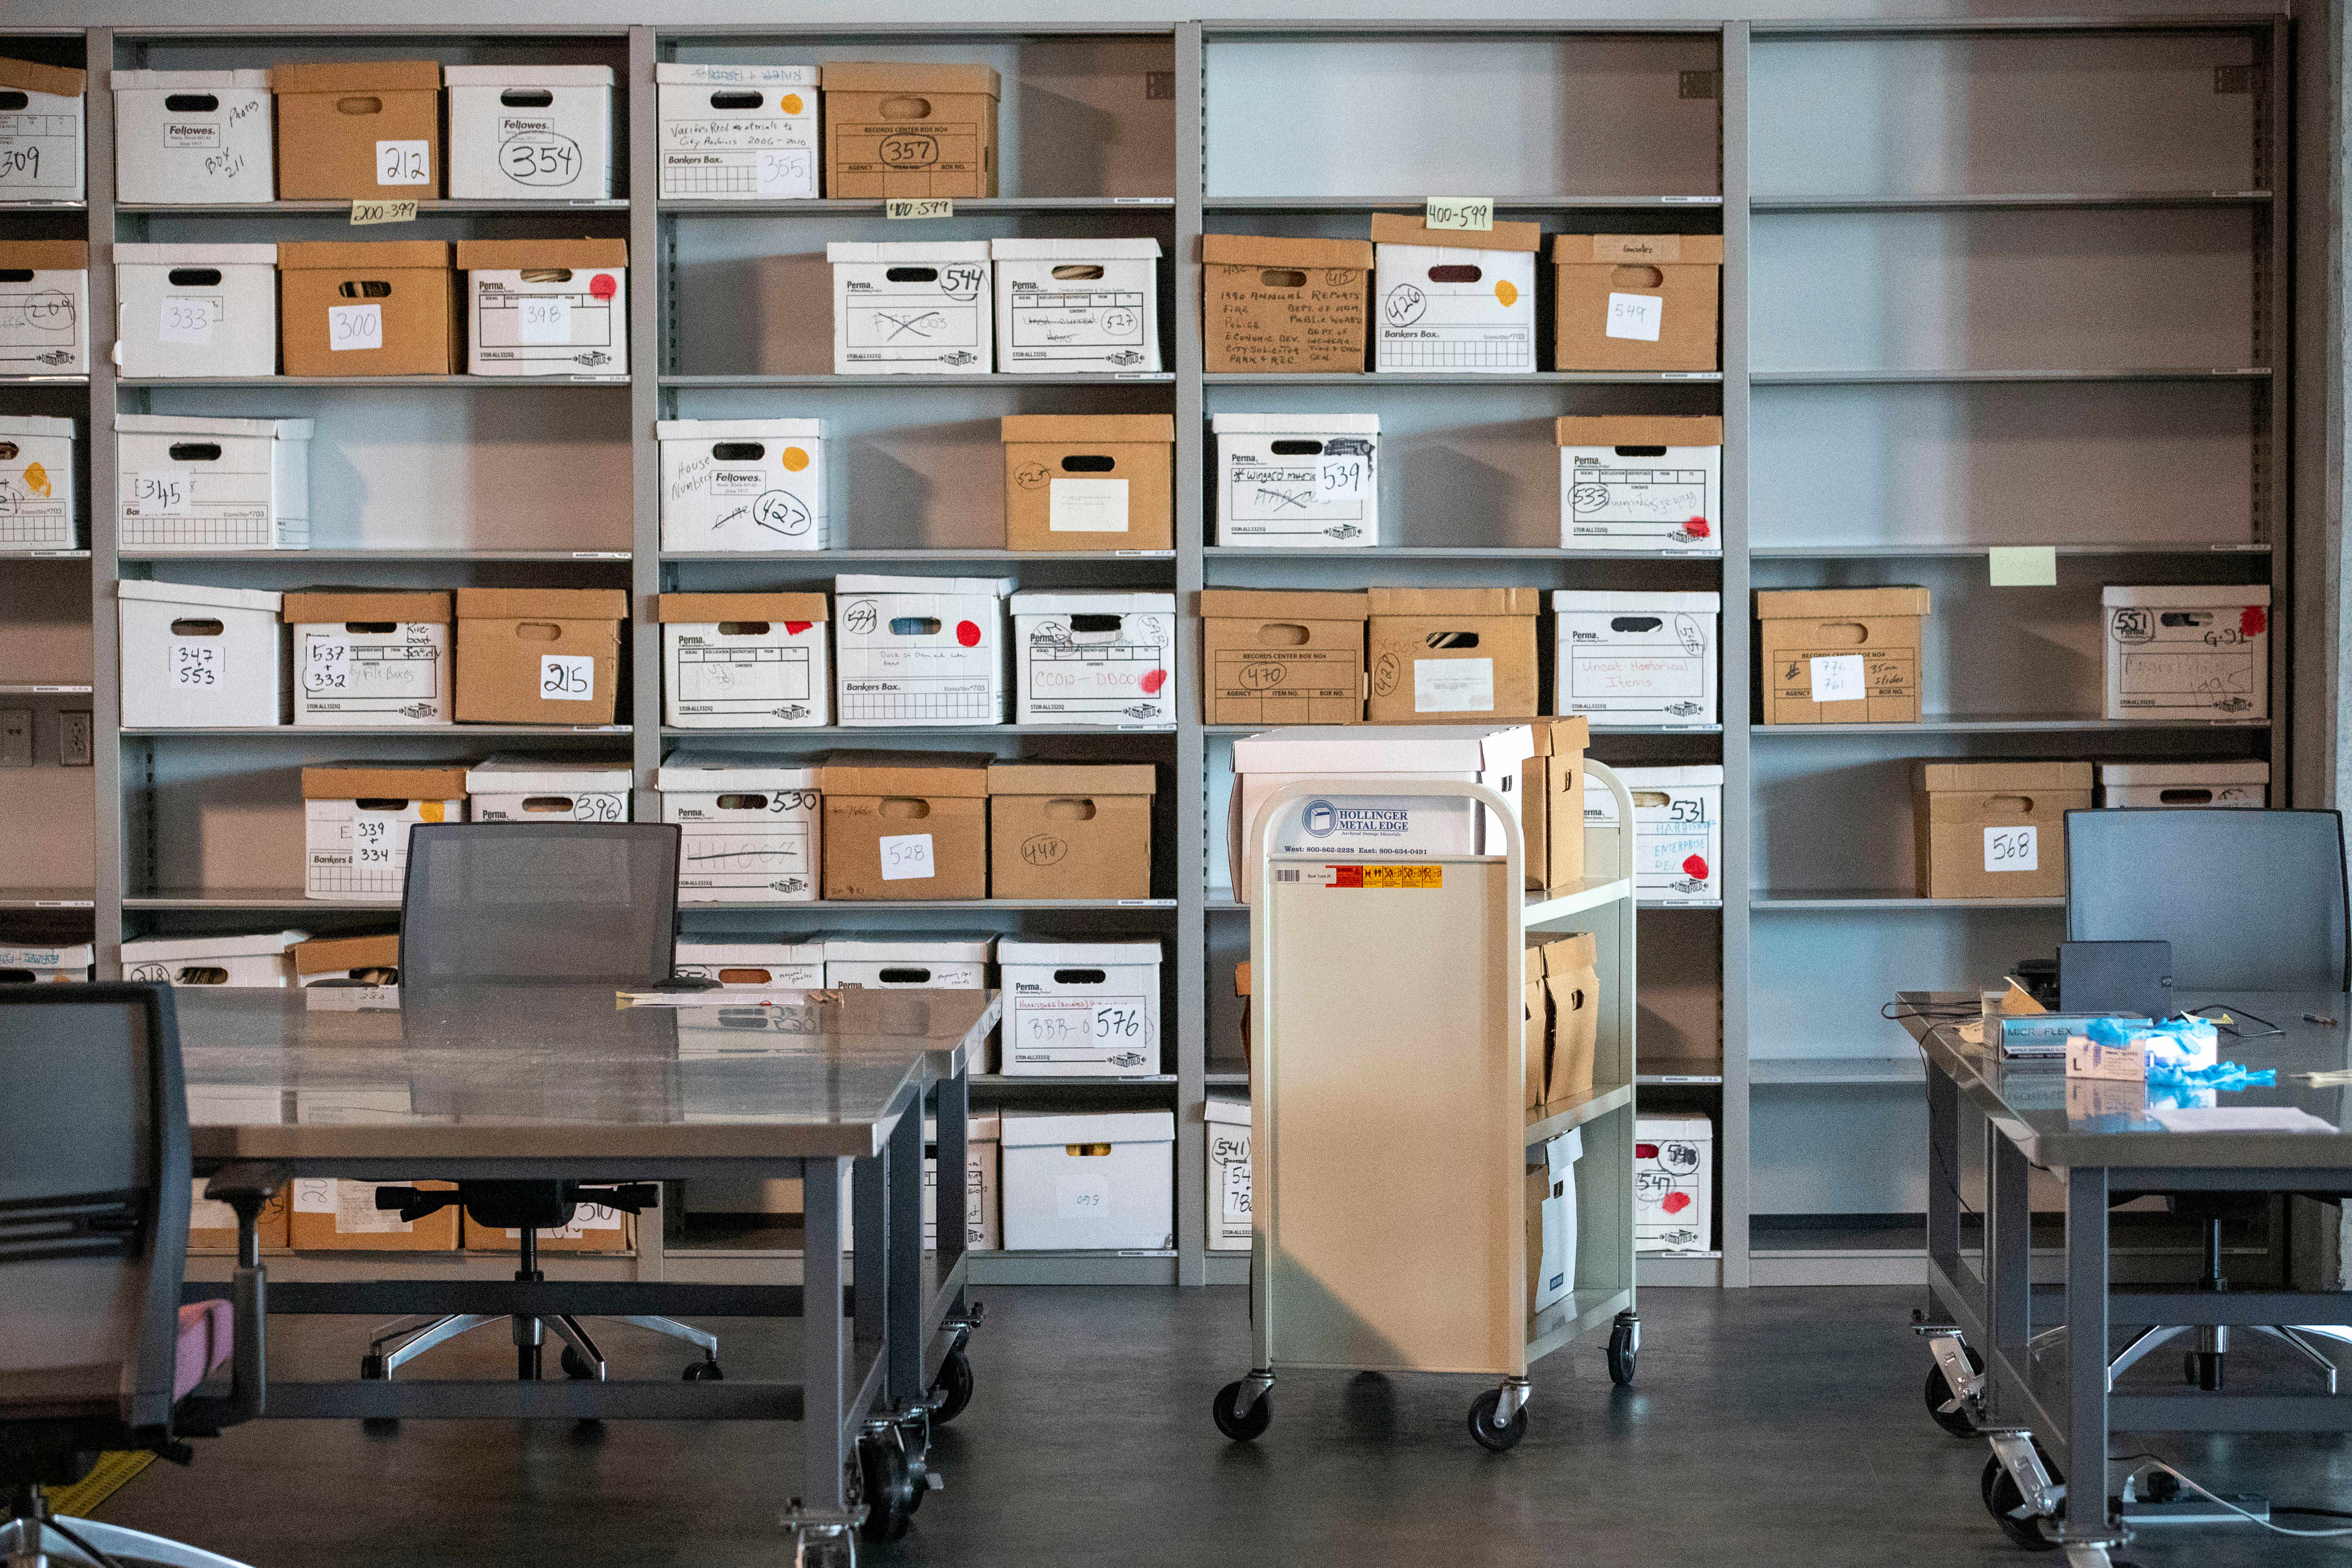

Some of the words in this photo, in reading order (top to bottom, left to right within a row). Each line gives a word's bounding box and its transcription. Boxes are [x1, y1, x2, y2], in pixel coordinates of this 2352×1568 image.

[669, 156, 701, 164] Bankers
[886, 141, 929, 160] 357
[0, 146, 39, 178] 309
[386, 148, 425, 178] 212
[513, 146, 572, 177] 354
[764, 155, 803, 183] 355
[354, 202, 414, 221] 200-399
[1429, 204, 1488, 228] 400-599
[947, 269, 984, 291] 544
[1328, 272, 1349, 283] 415
[1388, 288, 1420, 321] 426
[1615, 303, 1646, 323] 549
[170, 307, 207, 330] 333
[526, 305, 561, 324] 398
[1107, 314, 1134, 329] 527
[336, 312, 377, 339] 300
[1385, 330, 1418, 339] Bankers
[1324, 463, 1359, 491] 539
[140, 479, 180, 508] 345
[1572, 488, 1607, 506] 533
[763, 498, 805, 528] 427
[2115, 612, 2147, 630] 551
[179, 647, 213, 664] 347
[313, 645, 344, 662] 537
[181, 667, 214, 685] 553
[315, 673, 346, 688] 332
[544, 664, 587, 692] 215
[1248, 668, 1281, 688] 470
[847, 683, 879, 692] Bankers
[578, 798, 616, 822] 396
[770, 791, 816, 813] 530
[1670, 797, 1704, 823] 531
[1339, 811, 1408, 821] HOLLINGER
[359, 822, 384, 837] 339
[1339, 821, 1377, 830] METAL
[1379, 821, 1408, 831] EDGE
[361, 849, 388, 861] 334
[889, 842, 925, 865] 528
[1655, 839, 1705, 857] ENTERPRISE
[1993, 833, 2029, 860] 568
[314, 855, 346, 864] Bankers
[1097, 1008, 1139, 1037] 576
[2073, 1058, 2081, 1071] L
[1215, 1141, 1244, 1156] 541
[1638, 1174, 1670, 1194] 547
